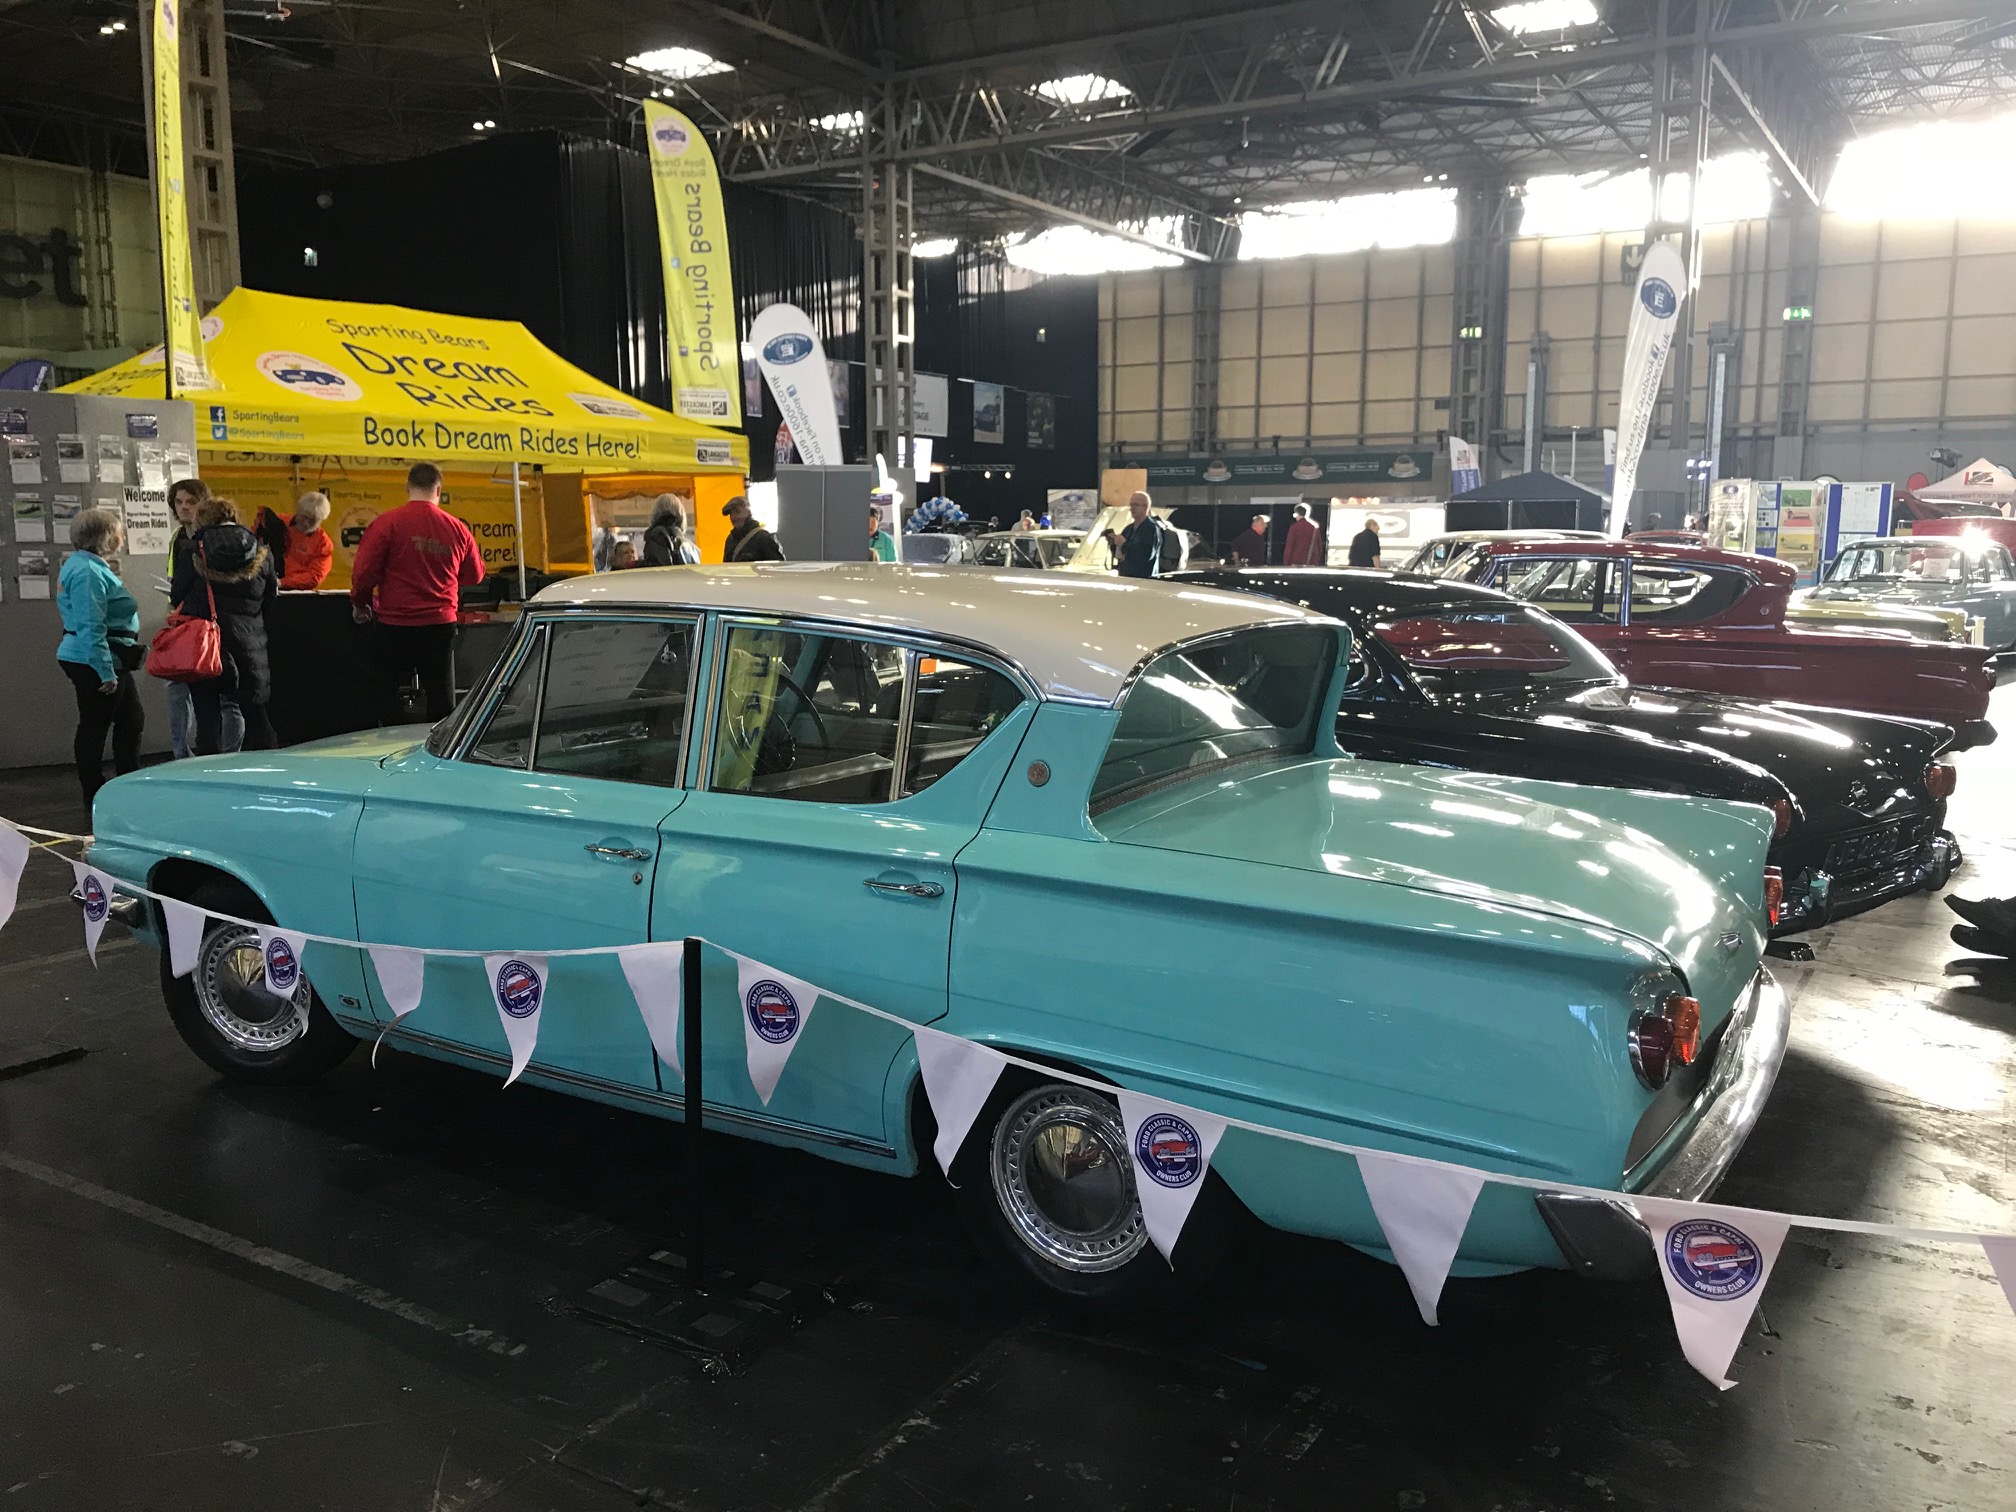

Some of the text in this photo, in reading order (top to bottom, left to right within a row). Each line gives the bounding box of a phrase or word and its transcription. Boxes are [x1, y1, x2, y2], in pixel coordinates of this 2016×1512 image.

[326, 318, 490, 351] Sporting Bears
[341, 341, 529, 389] Dream
[395, 381, 555, 417] Rides
[233, 410, 299, 424] SportingBears
[364, 416, 641, 460] Book Dream Rides Here!
[124, 487, 166, 502] Welcome
[126, 518, 168, 529] Dream Rides
[1141, 1130, 1151, 1148] FORD
[1148, 1119, 1171, 1132] CLASSIC
[1177, 1123, 1194, 1142] CAPRI
[1156, 1169, 1192, 1182] OWNERS CLUB
[1673, 1233, 1684, 1254] FORD
[1681, 1224, 1710, 1235] CLASSIC
[1719, 1226, 1745, 1245] CAPRI
[1694, 1277, 1746, 1294] OWNERS CLUB
